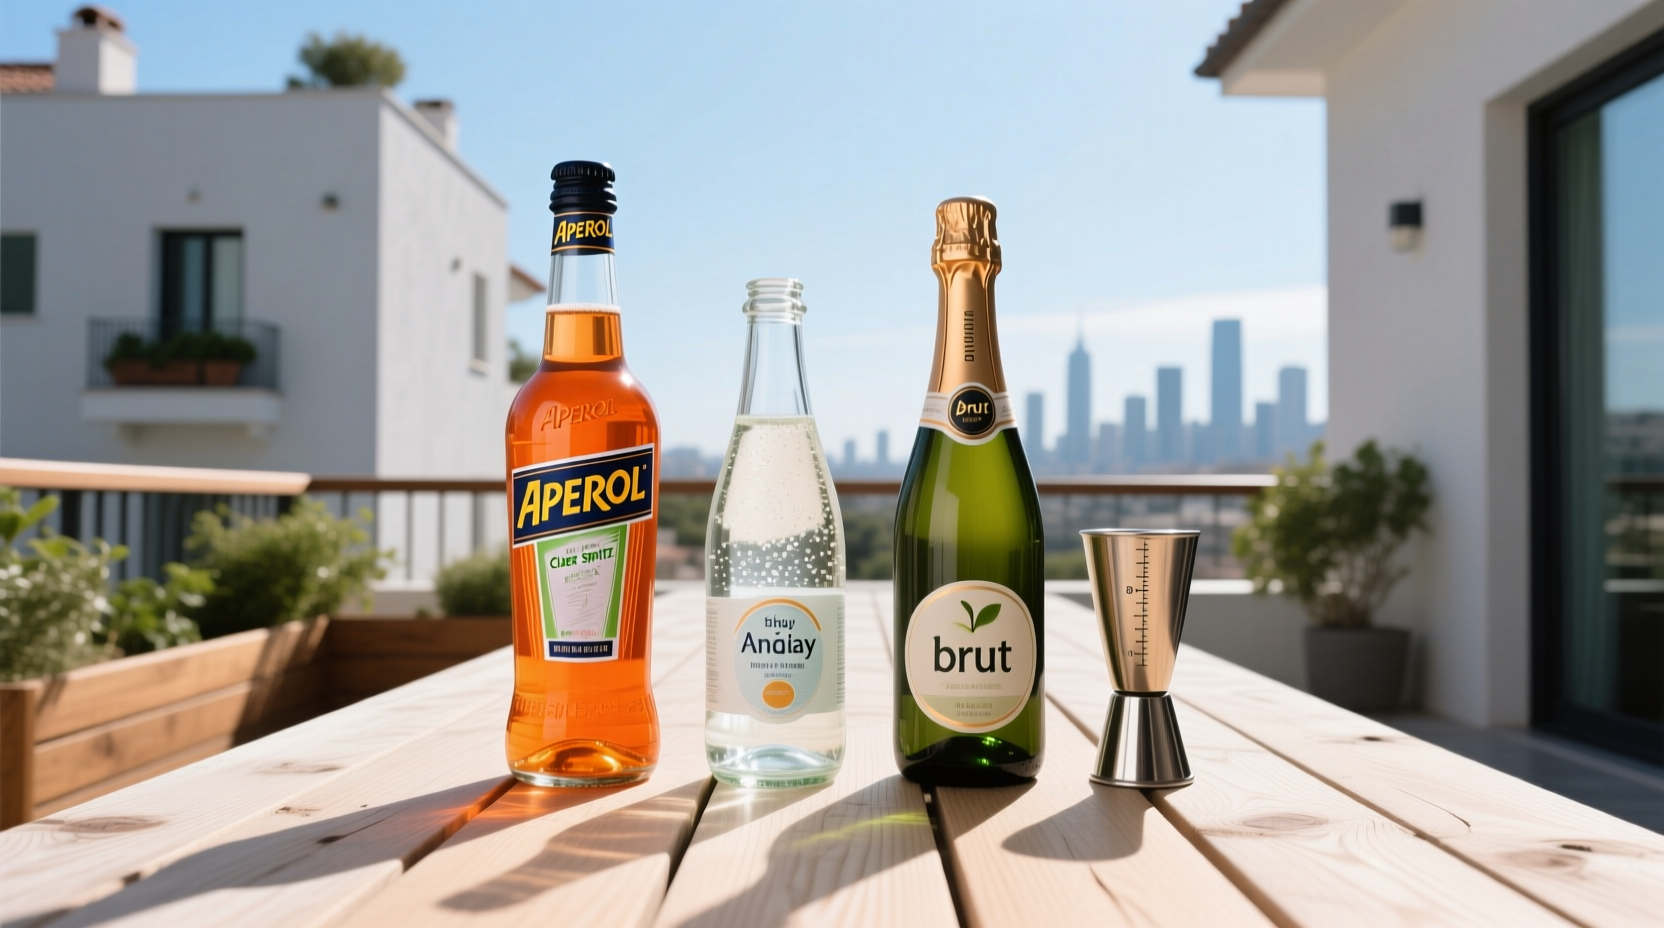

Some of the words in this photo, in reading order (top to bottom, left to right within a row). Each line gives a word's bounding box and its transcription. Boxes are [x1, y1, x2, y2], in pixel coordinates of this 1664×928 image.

[554, 219, 613, 246] APEROL
[517, 466, 646, 529] APEROL
[933, 635, 1012, 673] brut
